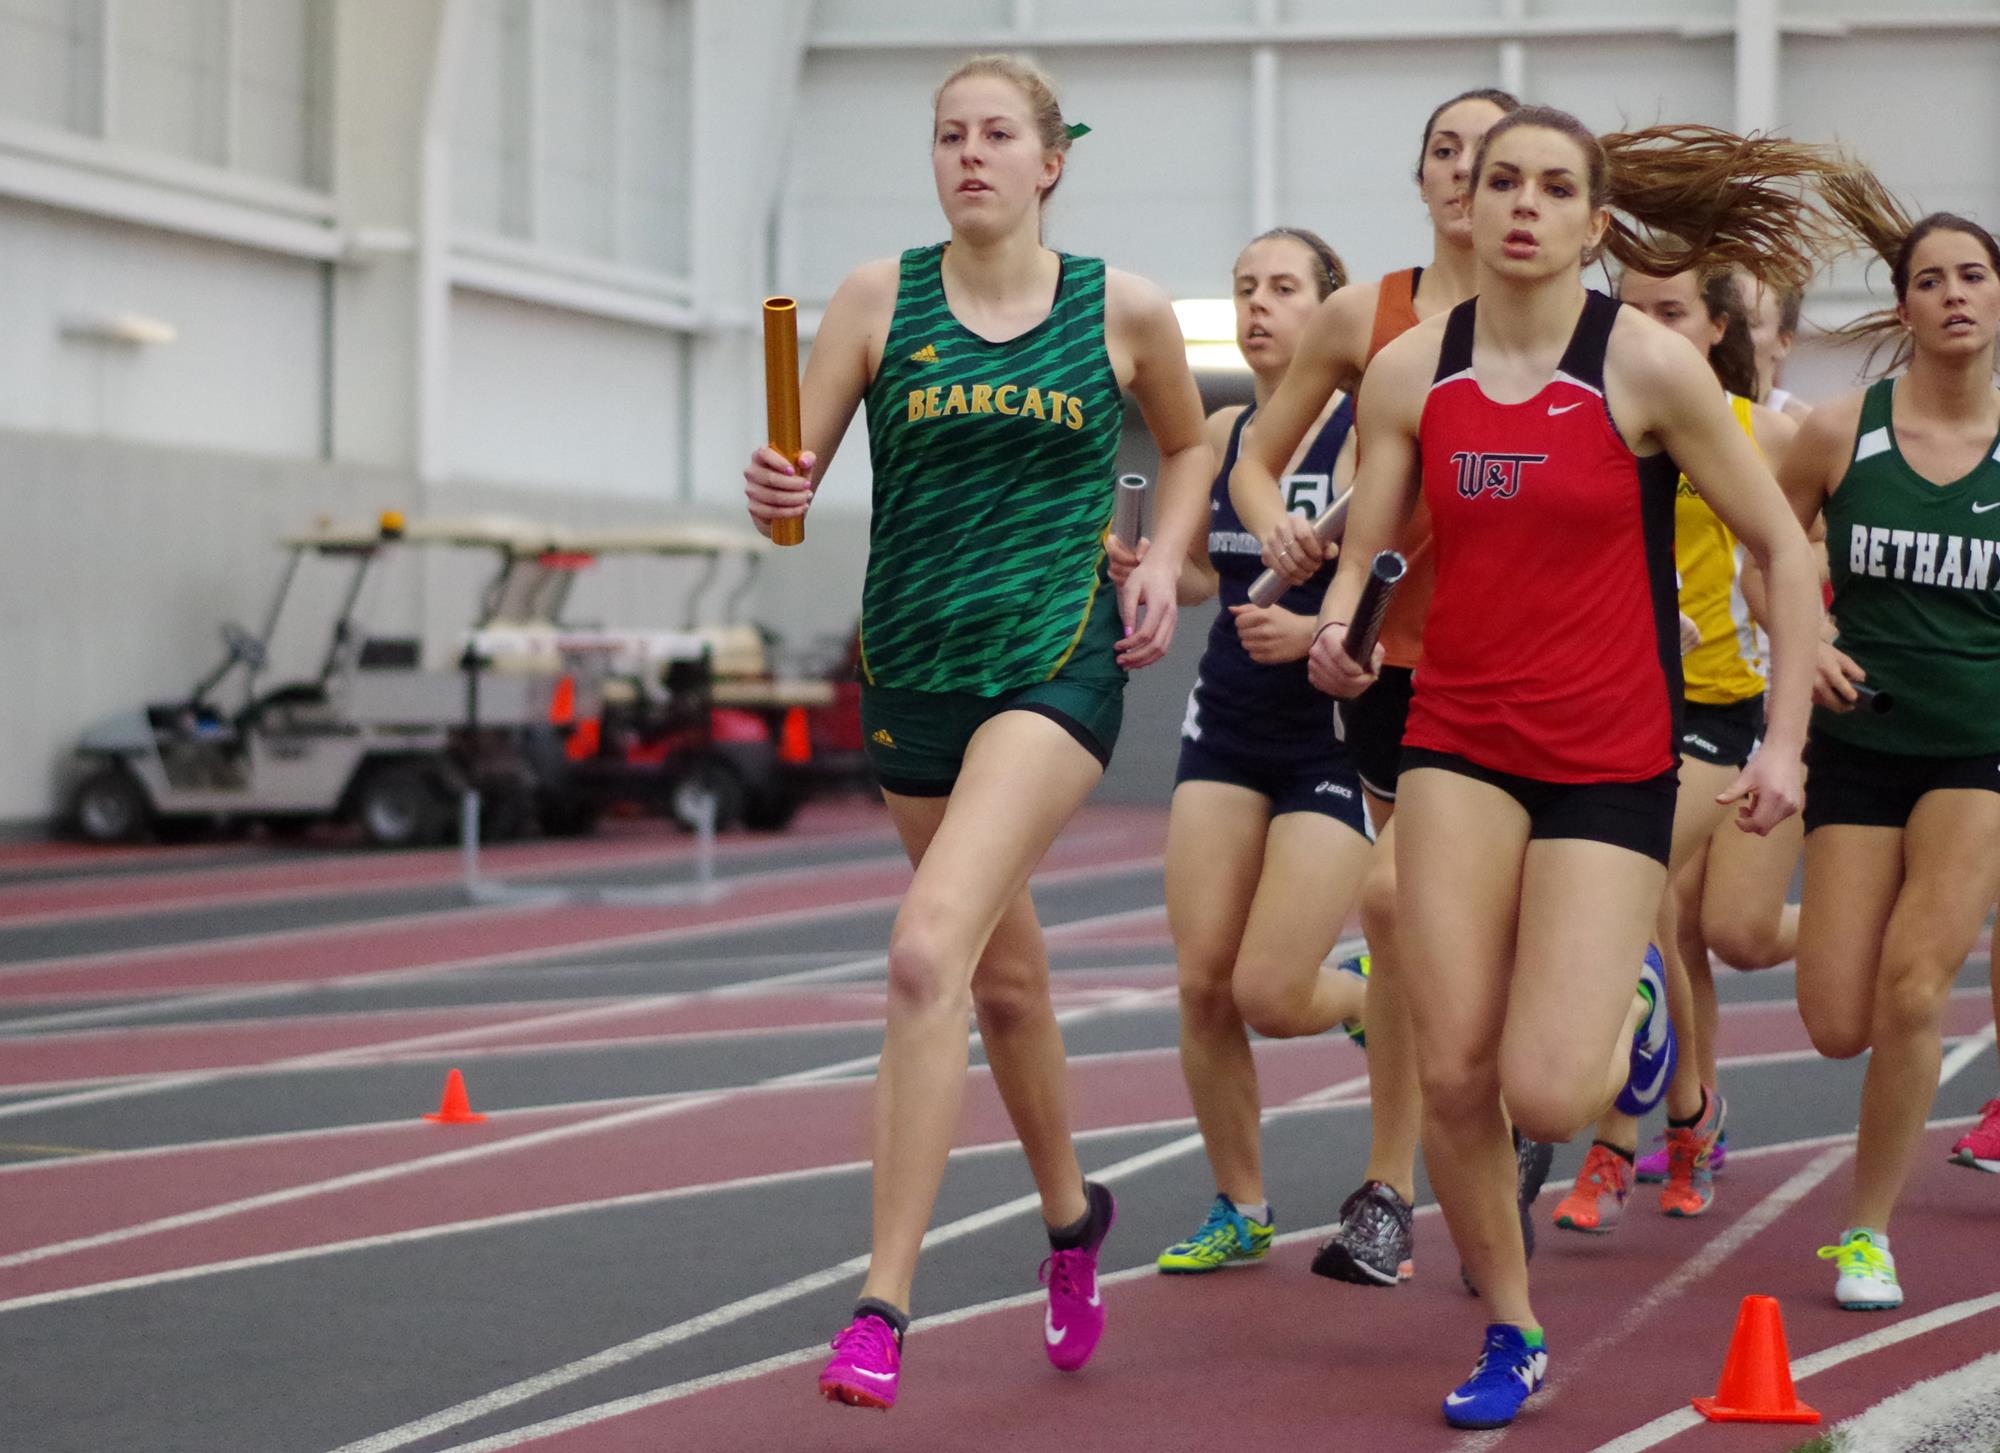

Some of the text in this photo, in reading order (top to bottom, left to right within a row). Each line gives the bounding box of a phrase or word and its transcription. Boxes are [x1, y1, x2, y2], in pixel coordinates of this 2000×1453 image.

[908, 384, 1084, 431] BEARCATS
[1286, 481, 1317, 520] 5
[1850, 524, 2000, 591] BETHAN
